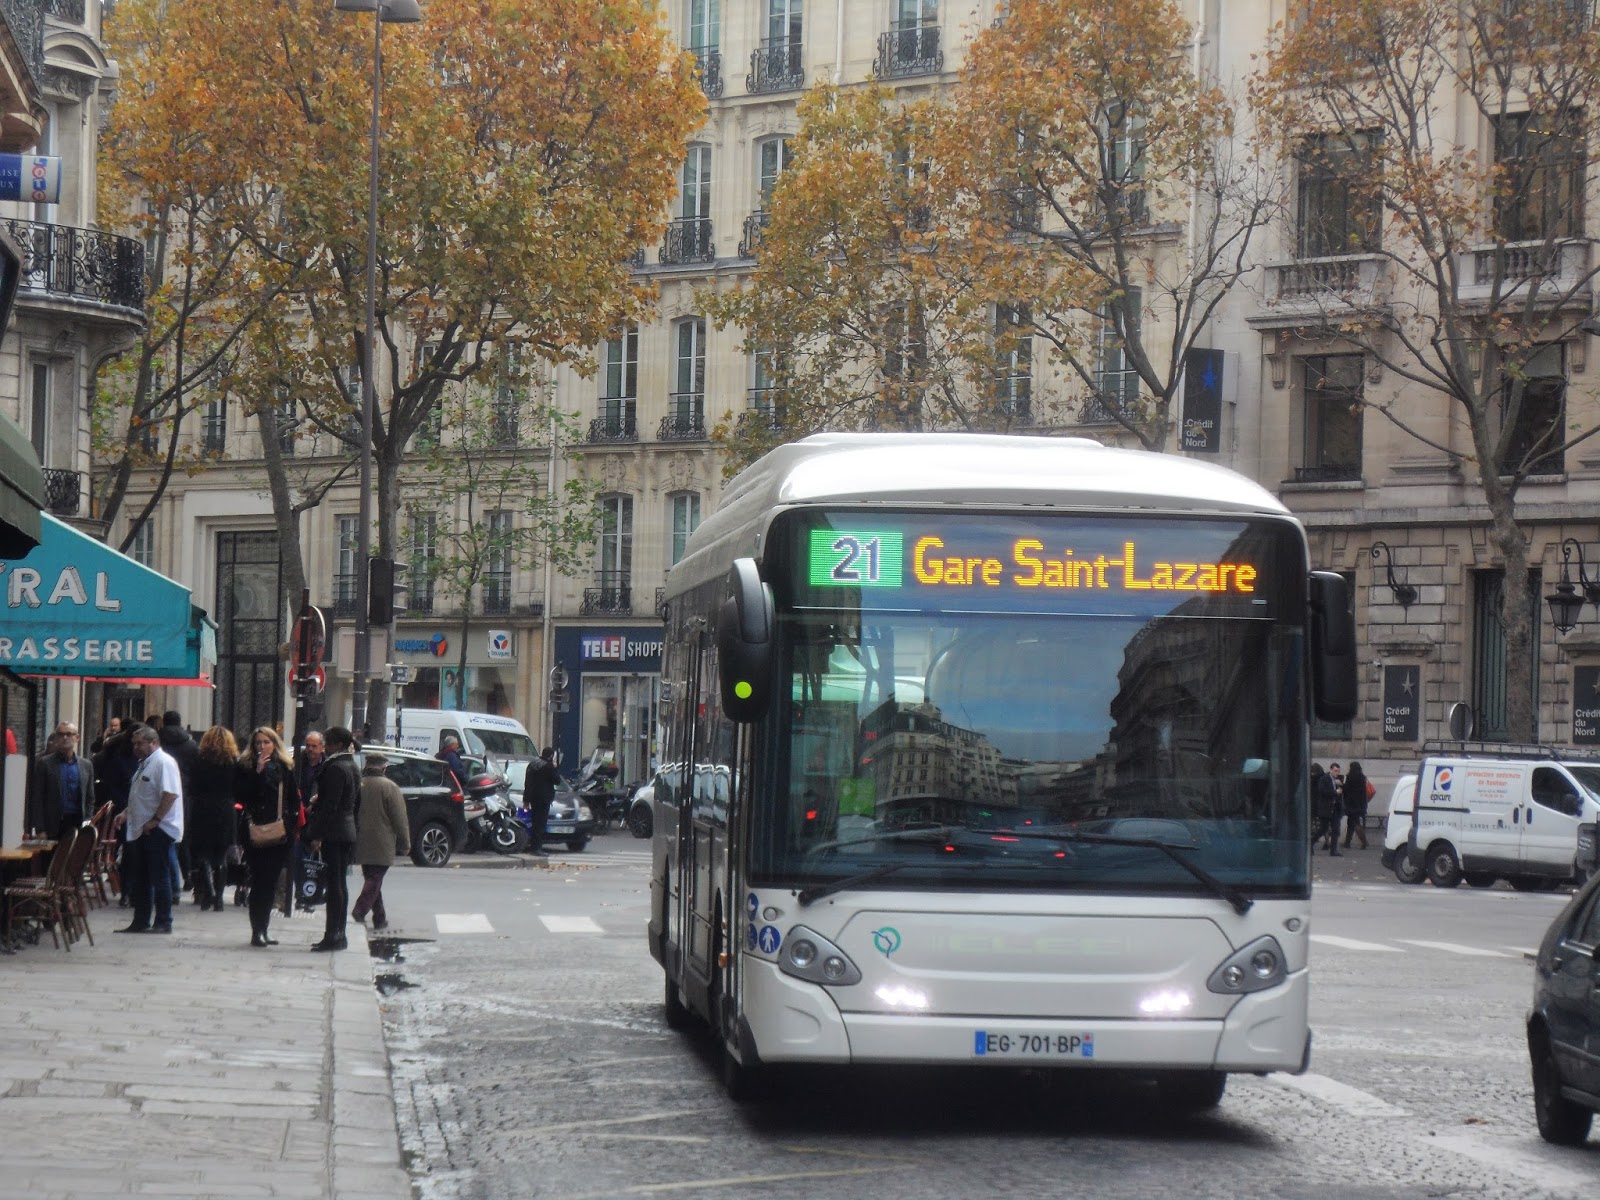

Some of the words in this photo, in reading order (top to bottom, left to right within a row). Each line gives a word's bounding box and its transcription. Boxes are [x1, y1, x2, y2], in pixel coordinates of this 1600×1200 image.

[0, 169, 19, 177] ISE
[32, 157, 47, 201] LOTO
[1185, 438, 1207, 447] Nord
[831, 536, 880, 582] 21
[914, 536, 1003, 586] Gare
[1013, 538, 1257, 592] Saint-Lazare
[0, 562, 121, 612] RAL
[583, 640, 620, 657] TELE
[1385, 707, 1410, 716] Crédit
[1385, 716, 1396, 724] du
[1575, 718, 1586, 727] du
[1385, 725, 1405, 733] Nord
[1575, 727, 1596, 736] Nord
